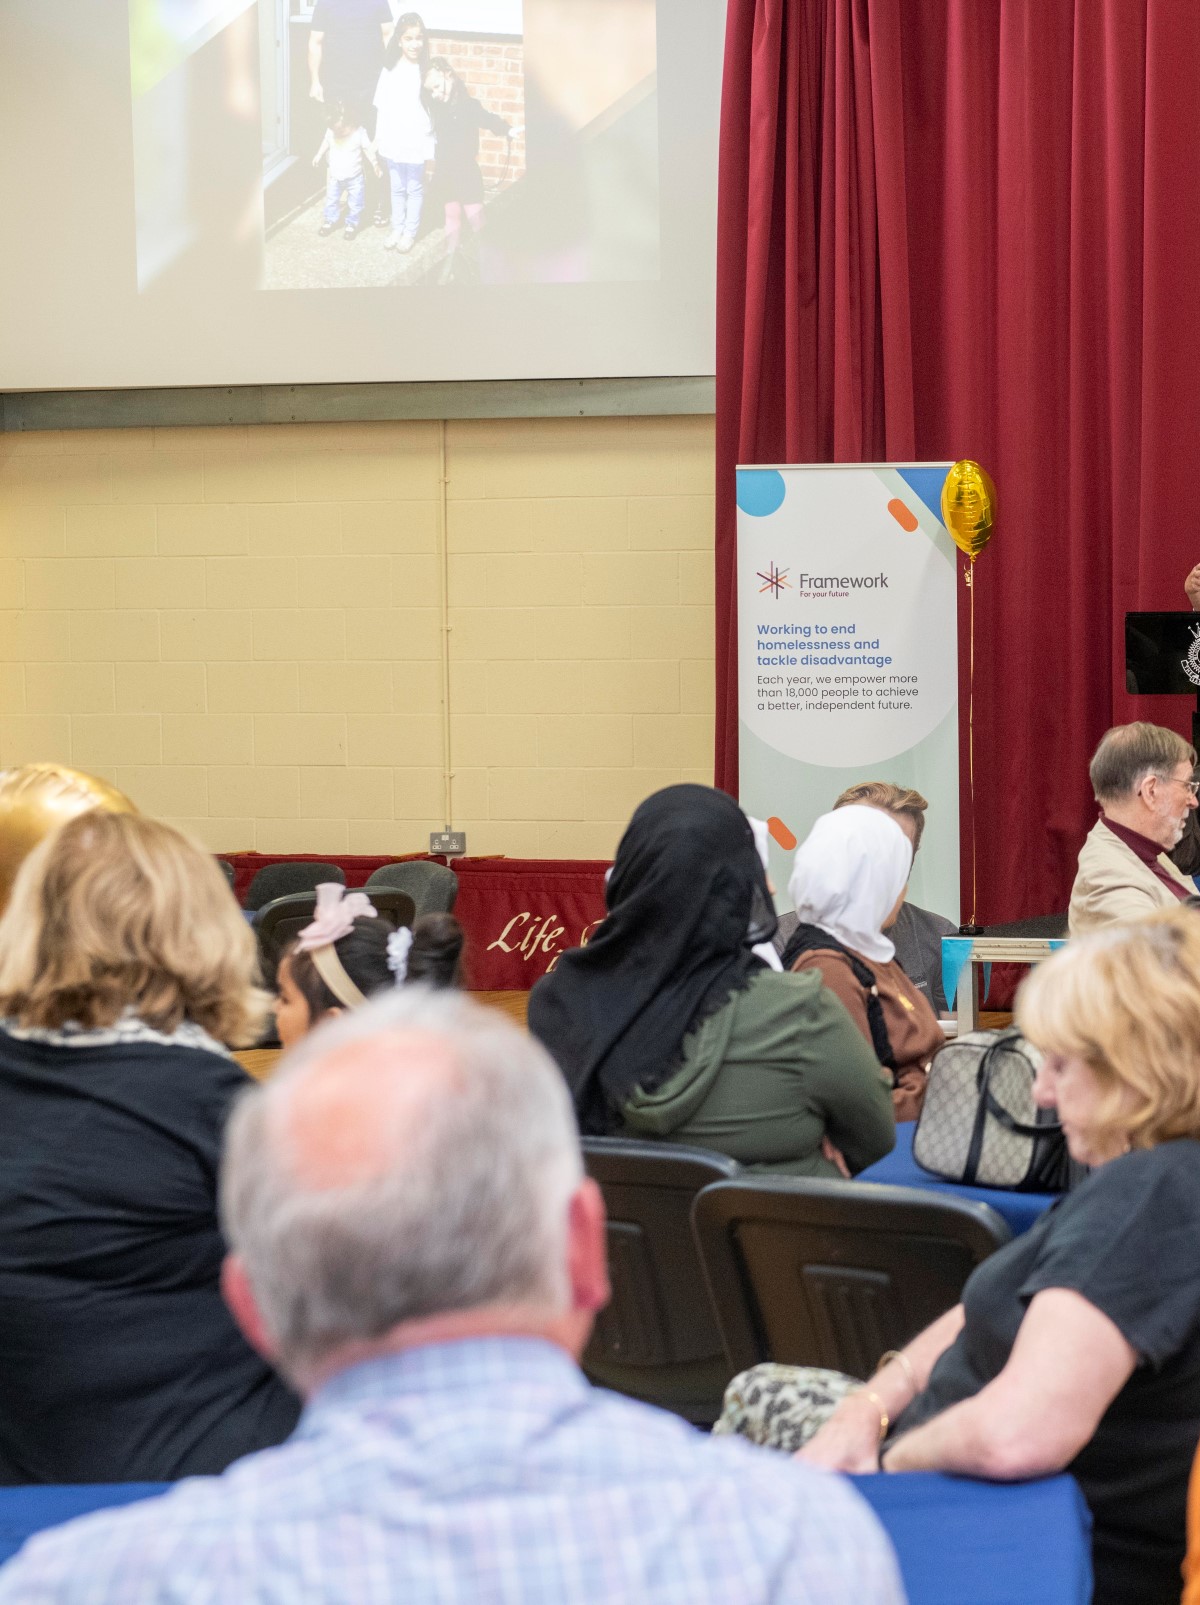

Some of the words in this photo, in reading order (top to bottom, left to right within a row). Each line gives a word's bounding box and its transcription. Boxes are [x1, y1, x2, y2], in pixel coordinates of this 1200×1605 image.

[800, 573, 888, 588] Framework
[799, 590, 811, 598] For
[813, 591, 828, 599] your
[829, 590, 850, 598] future
[757, 624, 811, 637] Working
[815, 625, 827, 634] to
[831, 624, 855, 634] end
[758, 640, 850, 650] homelessness
[854, 639, 879, 649] and
[757, 655, 797, 665] tackle
[801, 655, 892, 668] disadvantage
[758, 675, 783, 684] Each
[787, 677, 813, 687] year,
[816, 676, 832, 684] we
[835, 676, 886, 686] empower
[758, 688, 782, 697] than
[786, 688, 818, 698] 18,000
[822, 688, 859, 699] people
[862, 688, 872, 696] to
[876, 687, 918, 696] achieve
[768, 702, 803, 712] better,
[806, 701, 875, 712] independent
[878, 700, 913, 710] future.
[486, 912, 565, 961] Life
